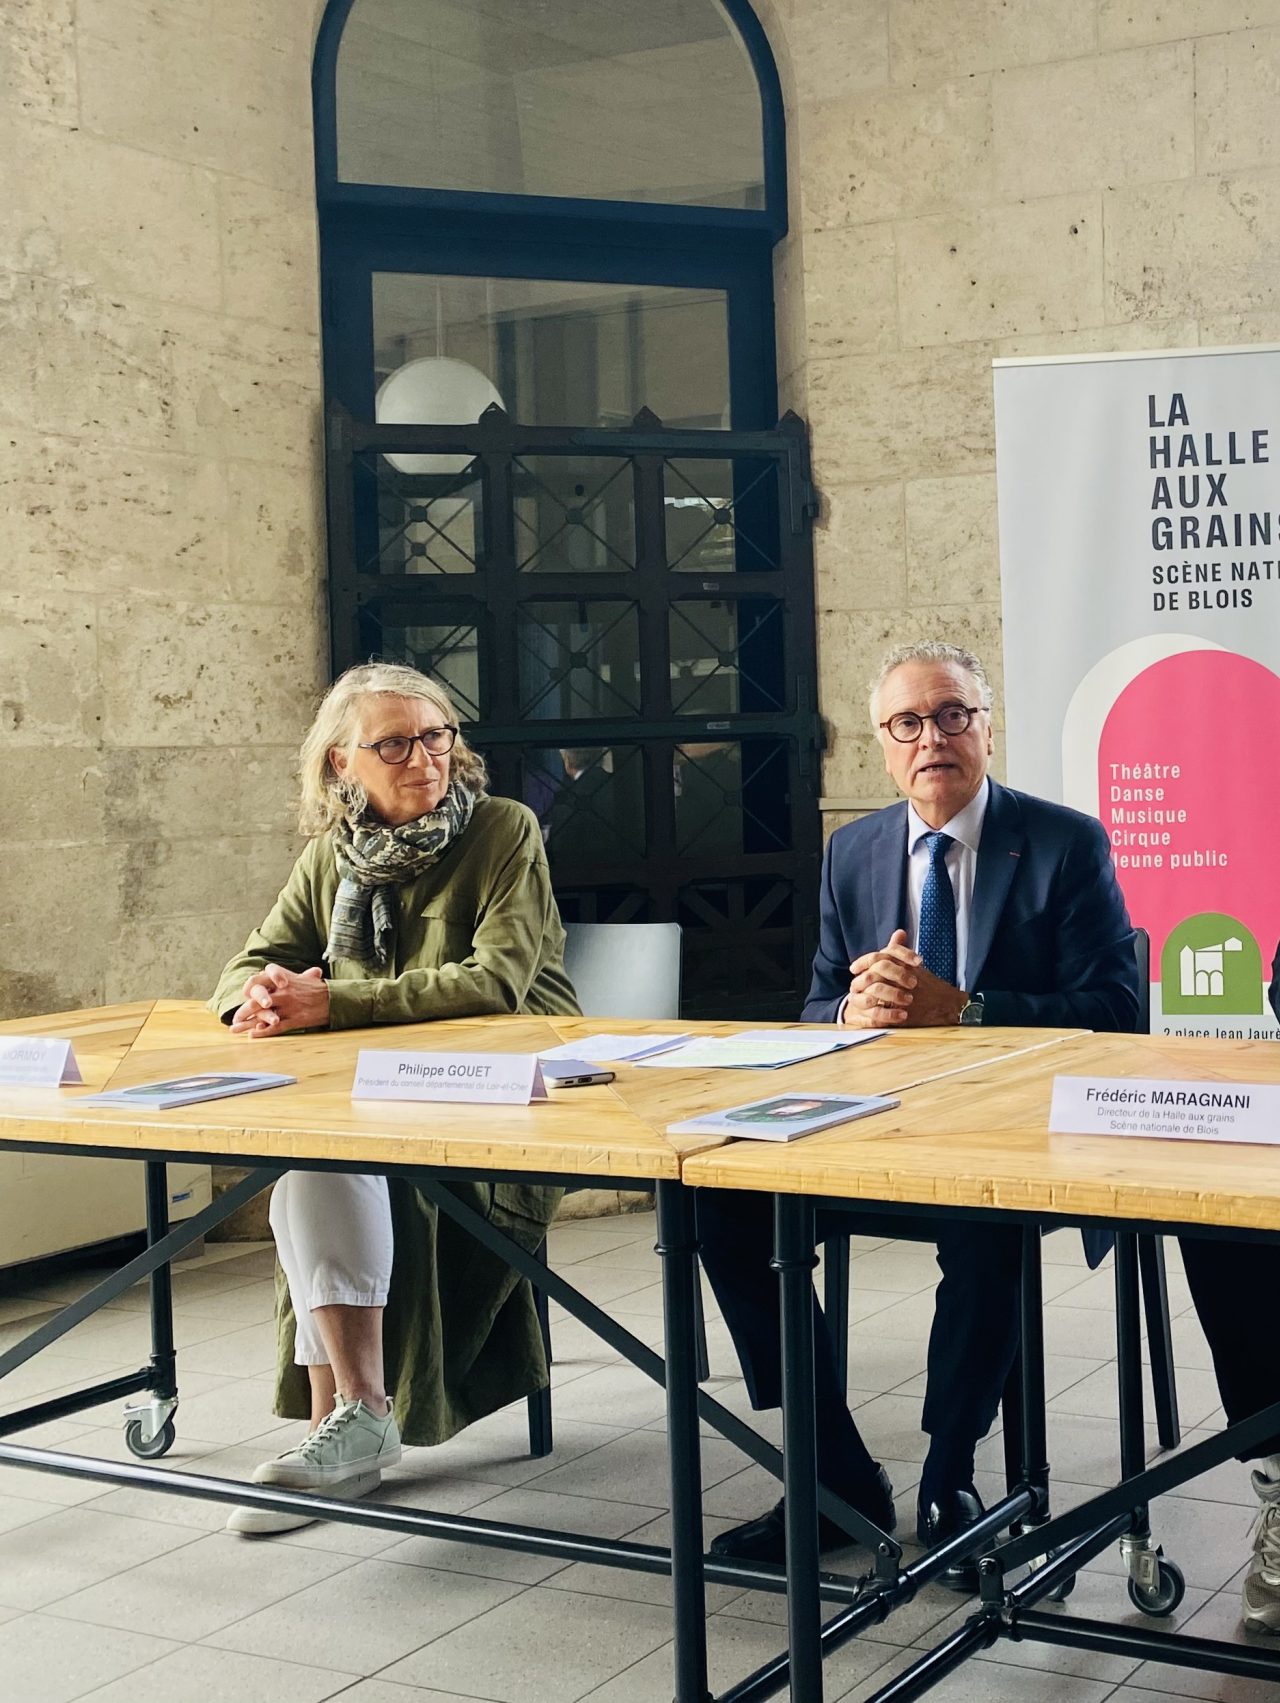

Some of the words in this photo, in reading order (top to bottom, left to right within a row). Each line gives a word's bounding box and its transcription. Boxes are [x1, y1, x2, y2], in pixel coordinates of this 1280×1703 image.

[1148, 393, 1189, 428] LA
[1150, 430, 1269, 469] HALLE
[1151, 473, 1228, 510] AUX
[1152, 560, 1222, 585] SCÈNE
[1153, 592, 1179, 611] DE
[1189, 588, 1253, 610] BLOIS
[1110, 763, 1180, 780] Théâtre
[1111, 785, 1165, 802] Danse
[1112, 807, 1187, 825] Musique
[1112, 829, 1171, 848] Cirque
[1170, 850, 1228, 869] public
[398, 1063, 445, 1078] Philippe
[448, 1064, 491, 1077] GOUET
[358, 1078, 390, 1087] Président
[390, 1079, 399, 1087] du
[401, 1080, 425, 1088] conseil
[426, 1080, 475, 1091] départemental
[476, 1082, 486, 1090] de
[1086, 1088, 1147, 1104] Frédéric
[1151, 1091, 1250, 1109] MARAGNANI
[1097, 1107, 1137, 1118] Directeur
[1139, 1109, 1150, 1118] de
[1152, 1109, 1161, 1119] la
[1163, 1110, 1187, 1120] Halle
[1188, 1113, 1205, 1121] aux
[1207, 1112, 1235, 1123] grains
[1110, 1120, 1138, 1131] Scène
[1140, 1122, 1181, 1133] nationale
[1183, 1124, 1195, 1133] de
[1197, 1125, 1220, 1135] Blois
